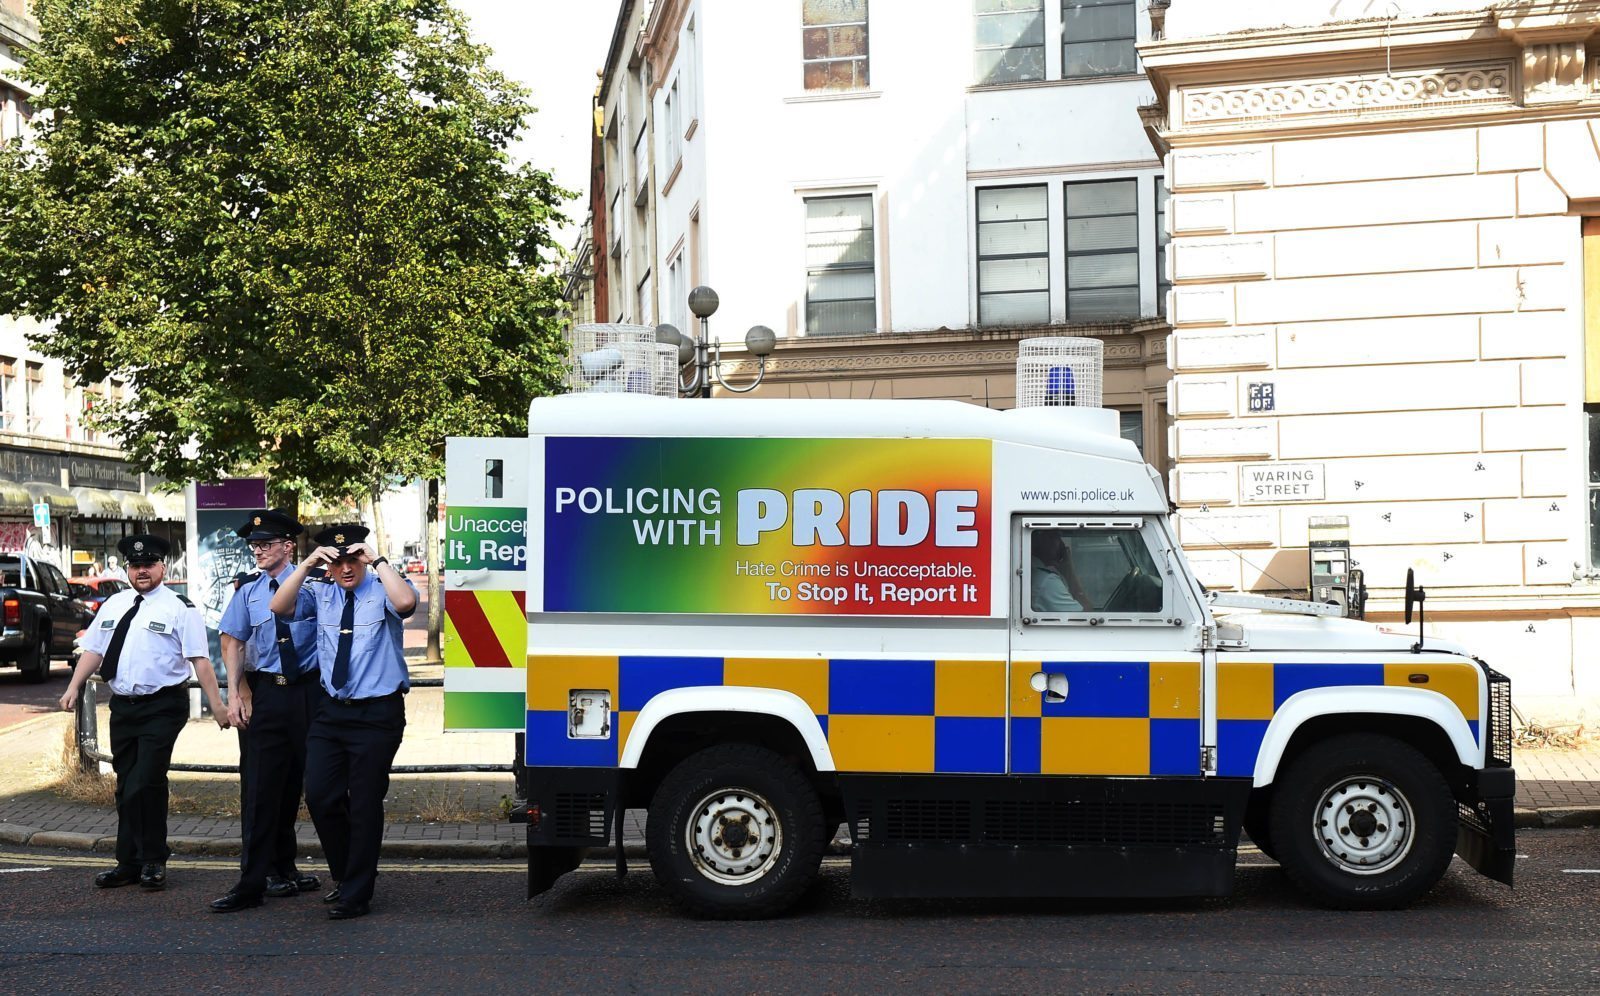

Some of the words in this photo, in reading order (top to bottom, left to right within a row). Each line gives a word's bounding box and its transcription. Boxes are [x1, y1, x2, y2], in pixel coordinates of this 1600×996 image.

[71, 461, 93, 481] Quality
[1252, 470, 1315, 482] WARING
[1020, 488, 1135, 504] www.psni.police.uk
[1255, 483, 1310, 496] STREET
[555, 487, 722, 515] POLICING
[736, 488, 979, 547] PRIDE
[632, 519, 722, 546] WITH
[449, 539, 472, 565] It,
[736, 560, 776, 577] Hate
[780, 560, 831, 577] Crime
[835, 561, 849, 577] is
[853, 561, 977, 581] Unacceptable.
[765, 582, 792, 601] To
[796, 582, 848, 606] Stop
[853, 582, 875, 605] It,
[880, 583, 957, 606] Report
[962, 583, 978, 602] It
